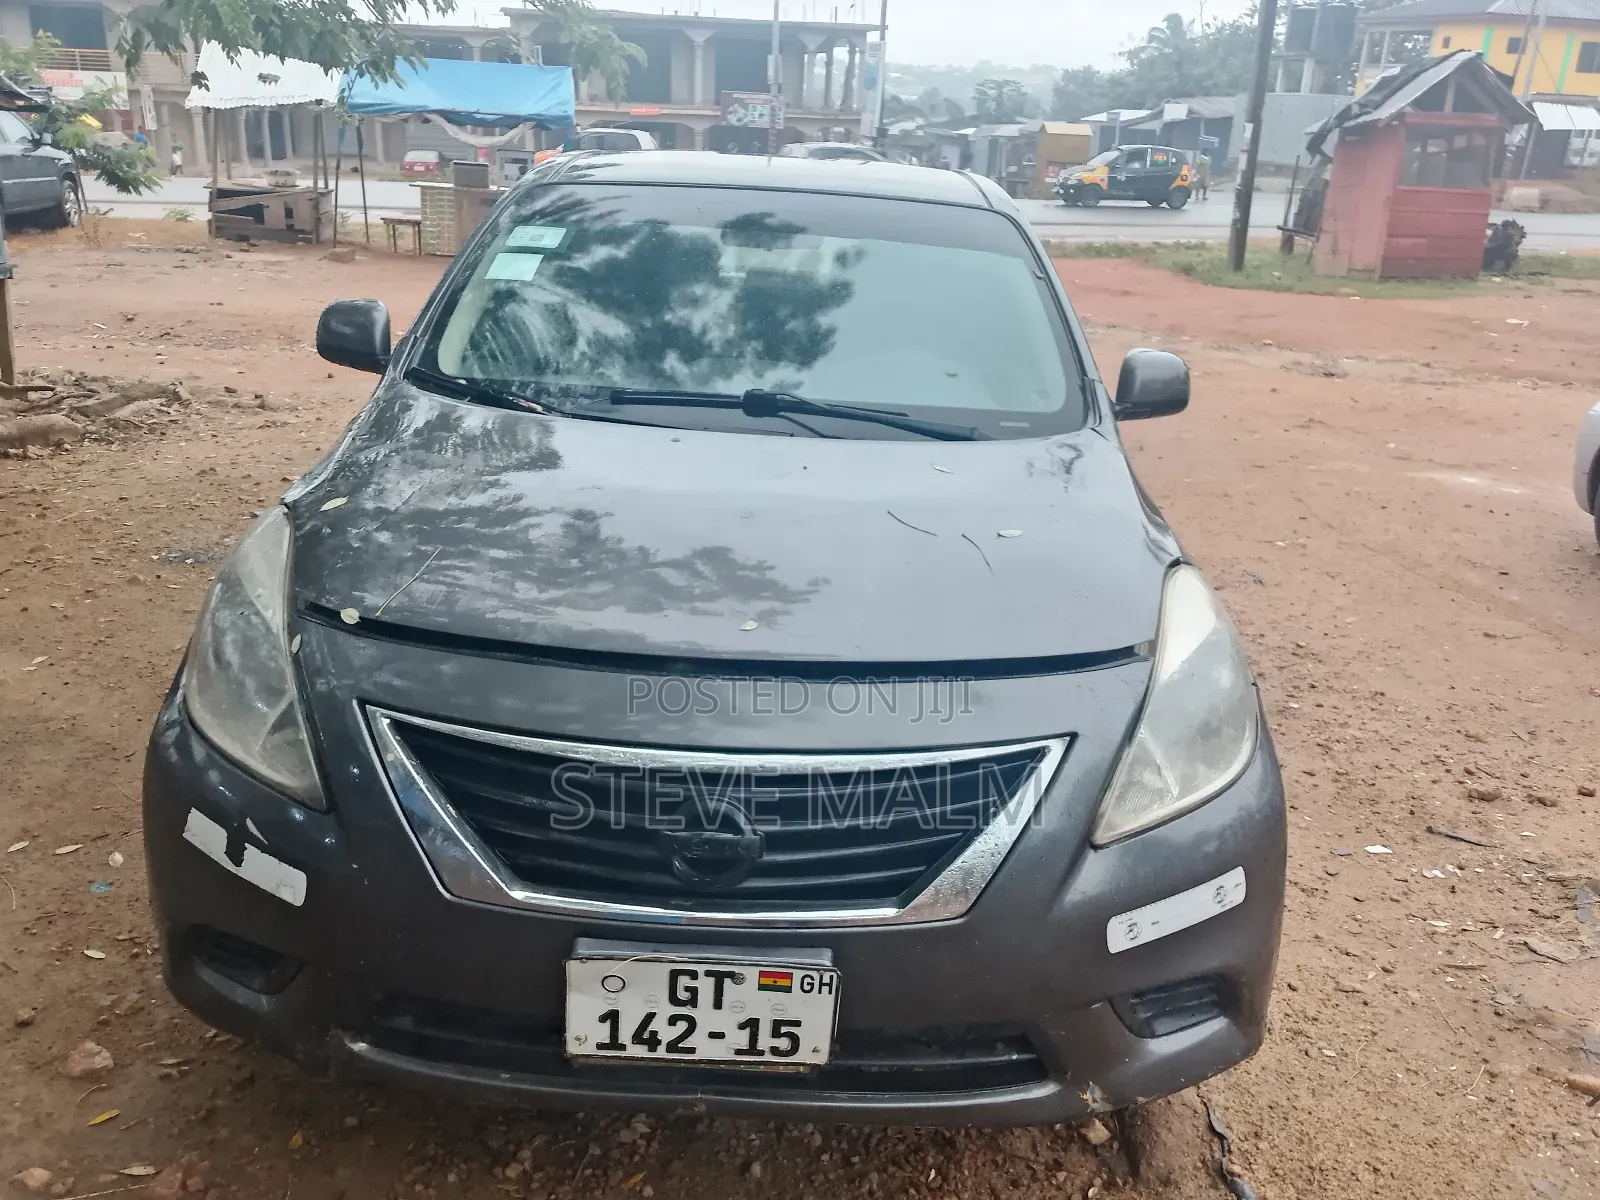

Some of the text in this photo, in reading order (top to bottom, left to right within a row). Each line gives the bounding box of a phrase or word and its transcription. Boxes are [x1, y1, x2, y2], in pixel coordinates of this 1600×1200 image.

[669, 968, 736, 1010] GT
[800, 974, 834, 995] GH
[596, 1008, 802, 1057] 142-15
